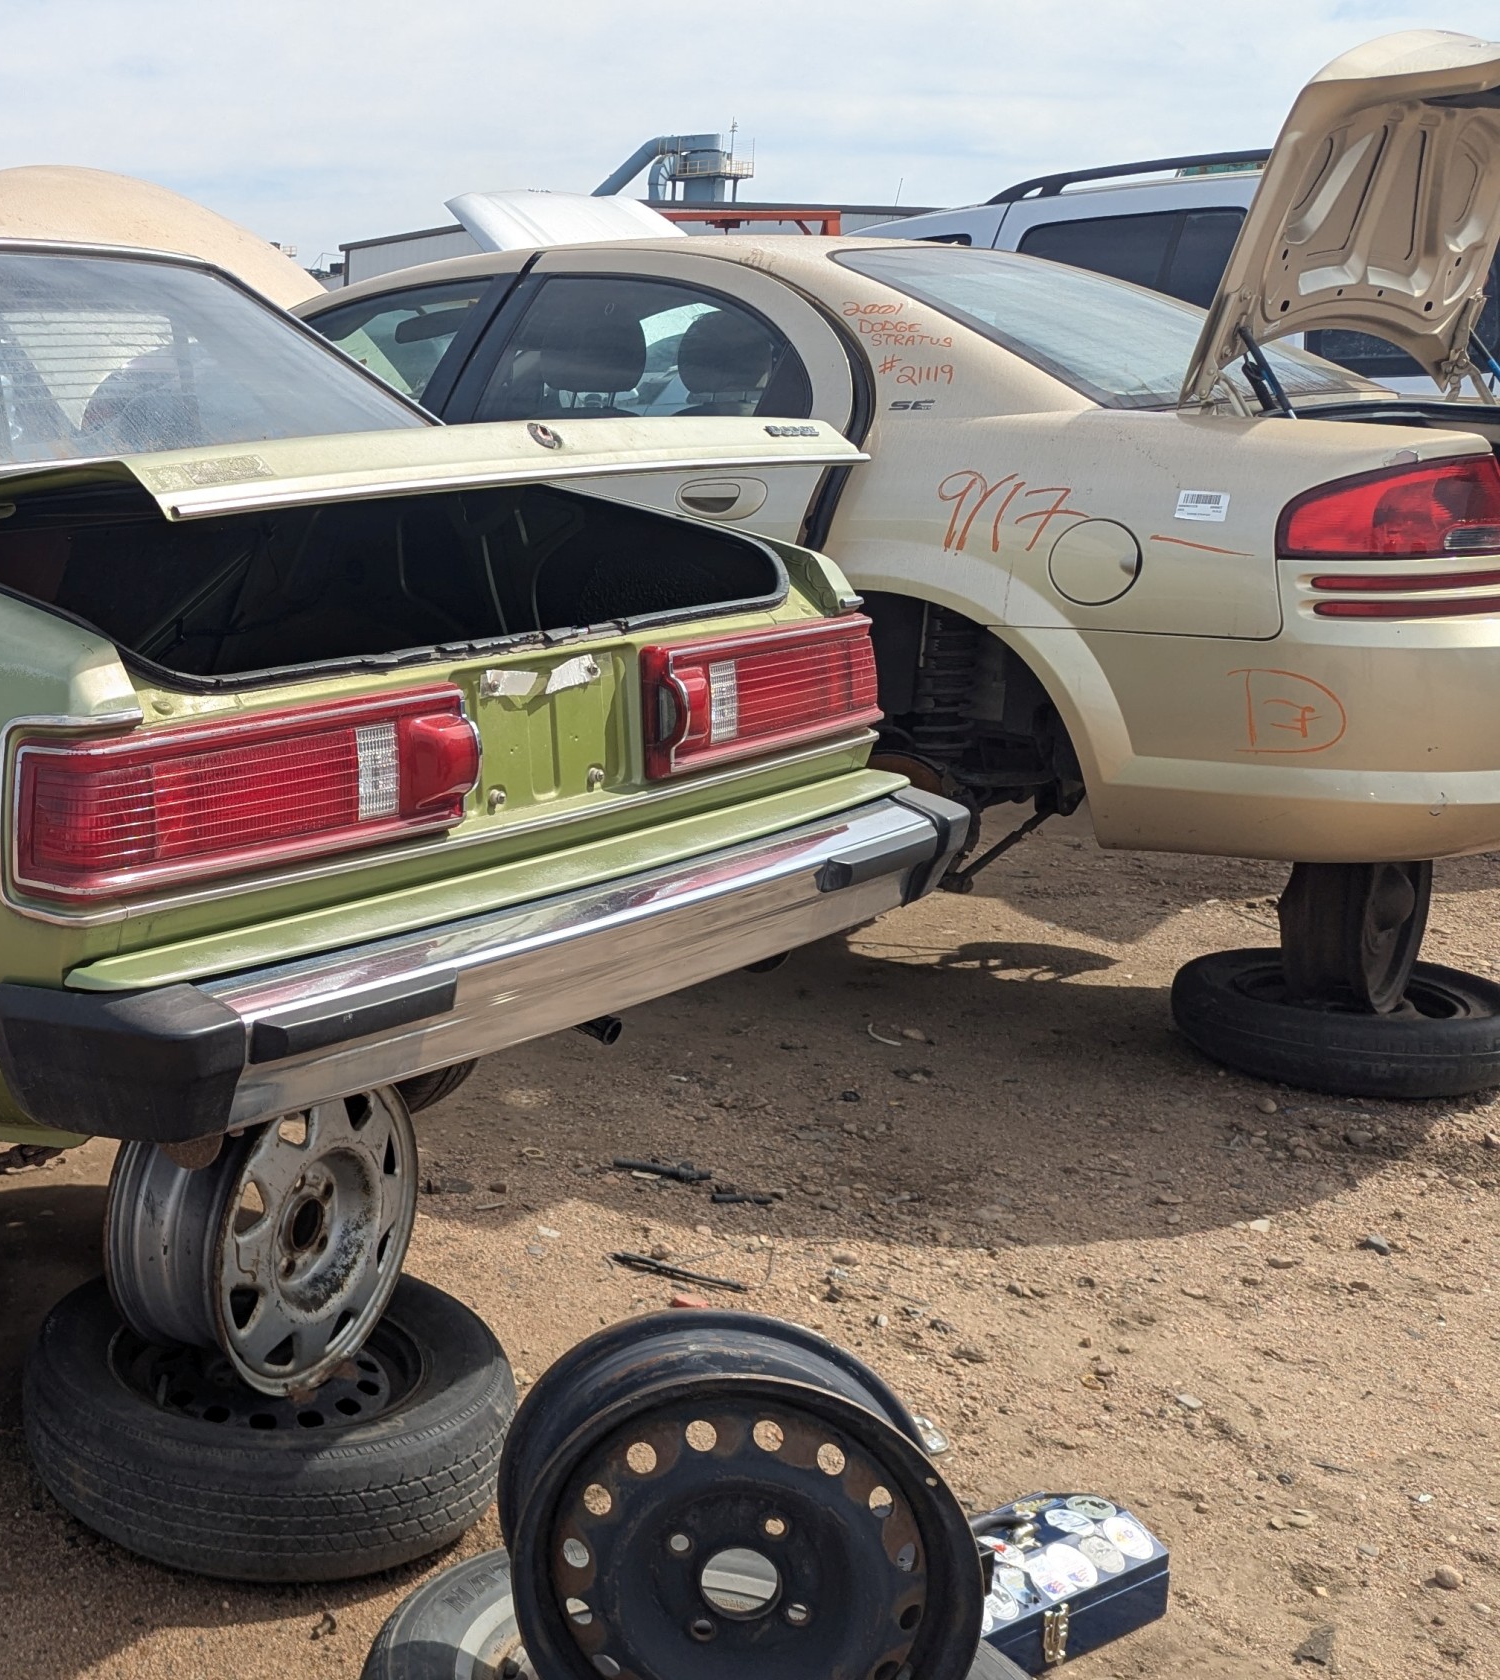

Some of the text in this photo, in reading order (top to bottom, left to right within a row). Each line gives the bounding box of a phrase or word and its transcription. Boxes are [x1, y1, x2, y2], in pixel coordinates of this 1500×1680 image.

[842, 301, 903, 316] 2001
[858, 318, 922, 334] DODGE
[871, 333, 953, 347] STRATUS
[896, 364, 954, 387] 21119
[888, 399, 936, 411] SE
